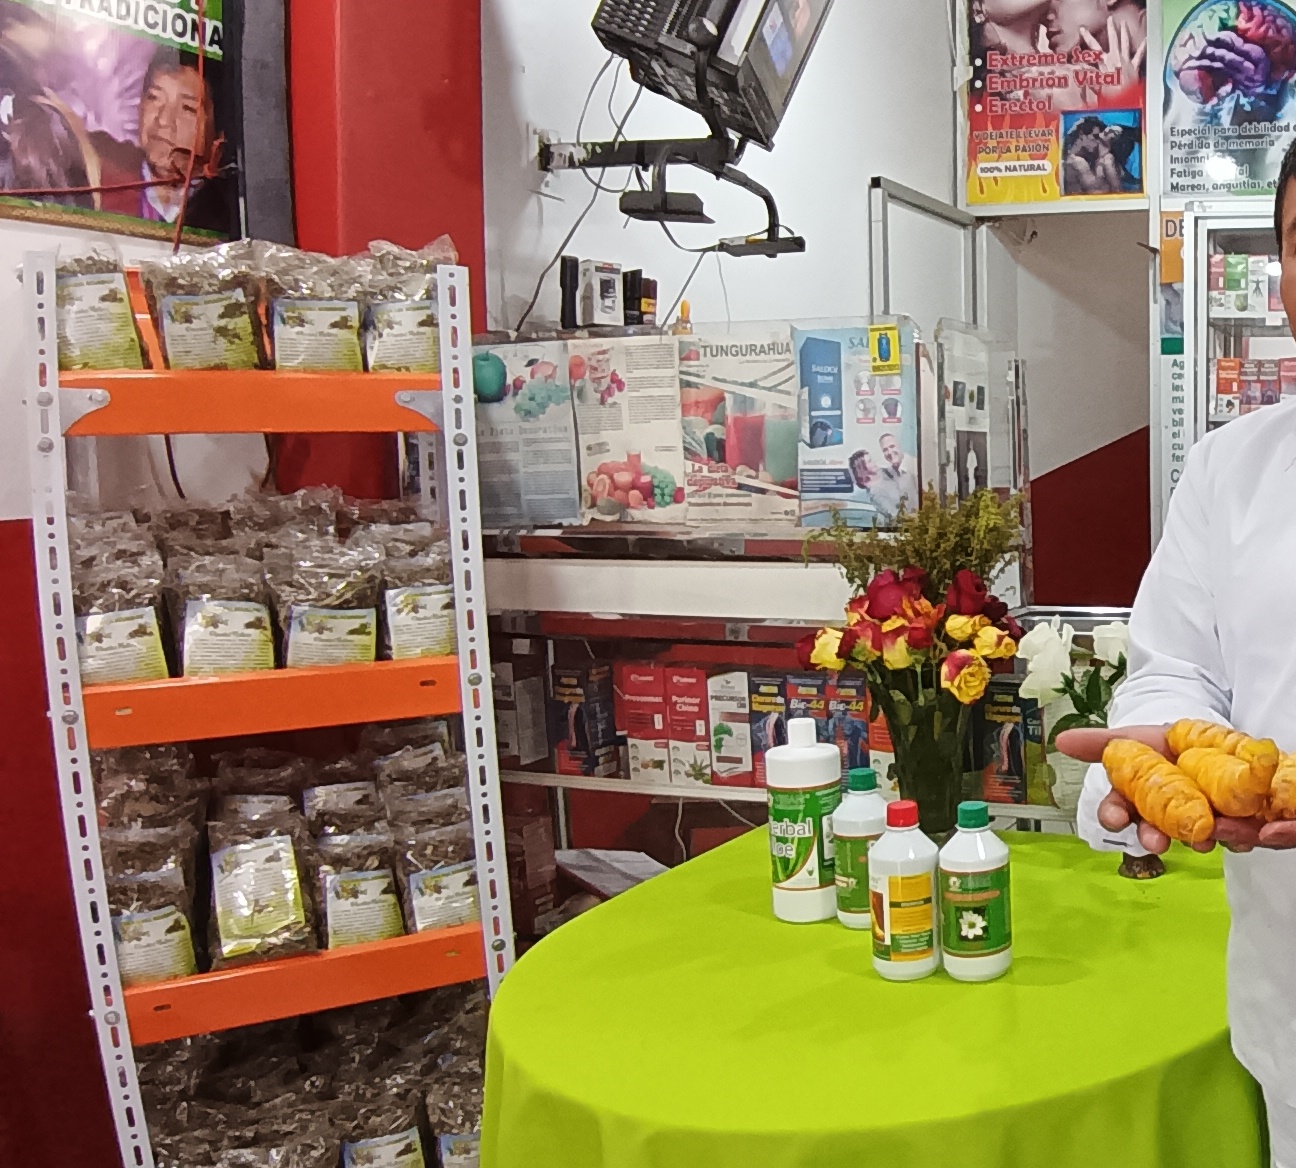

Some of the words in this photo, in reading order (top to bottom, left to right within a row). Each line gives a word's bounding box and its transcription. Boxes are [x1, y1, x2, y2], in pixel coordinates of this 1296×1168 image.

[66, 0, 223, 50] RADICIONA
[988, 51, 1067, 69] Extreme
[1072, 48, 1103, 64] Sex
[1074, 67, 1122, 87] Vital
[988, 94, 1053, 115] Erectol
[1016, 128, 1054, 139] LLEVAR
[1170, 126, 1211, 138] Especial
[1214, 127, 1239, 138] para
[1241, 122, 1290, 134] debilidad
[978, 145, 998, 154] POR
[1000, 145, 1012, 154] LA
[1213, 139, 1226, 149] de
[1227, 137, 1275, 148] memoria
[980, 165, 1002, 174] 100%
[1005, 163, 1047, 173] NATURAL
[1170, 167, 1203, 180] Fatiga
[701, 341, 792, 358] TUNGURAHUA
[772, 819, 813, 836] erbal
[773, 842, 794, 857] loe
